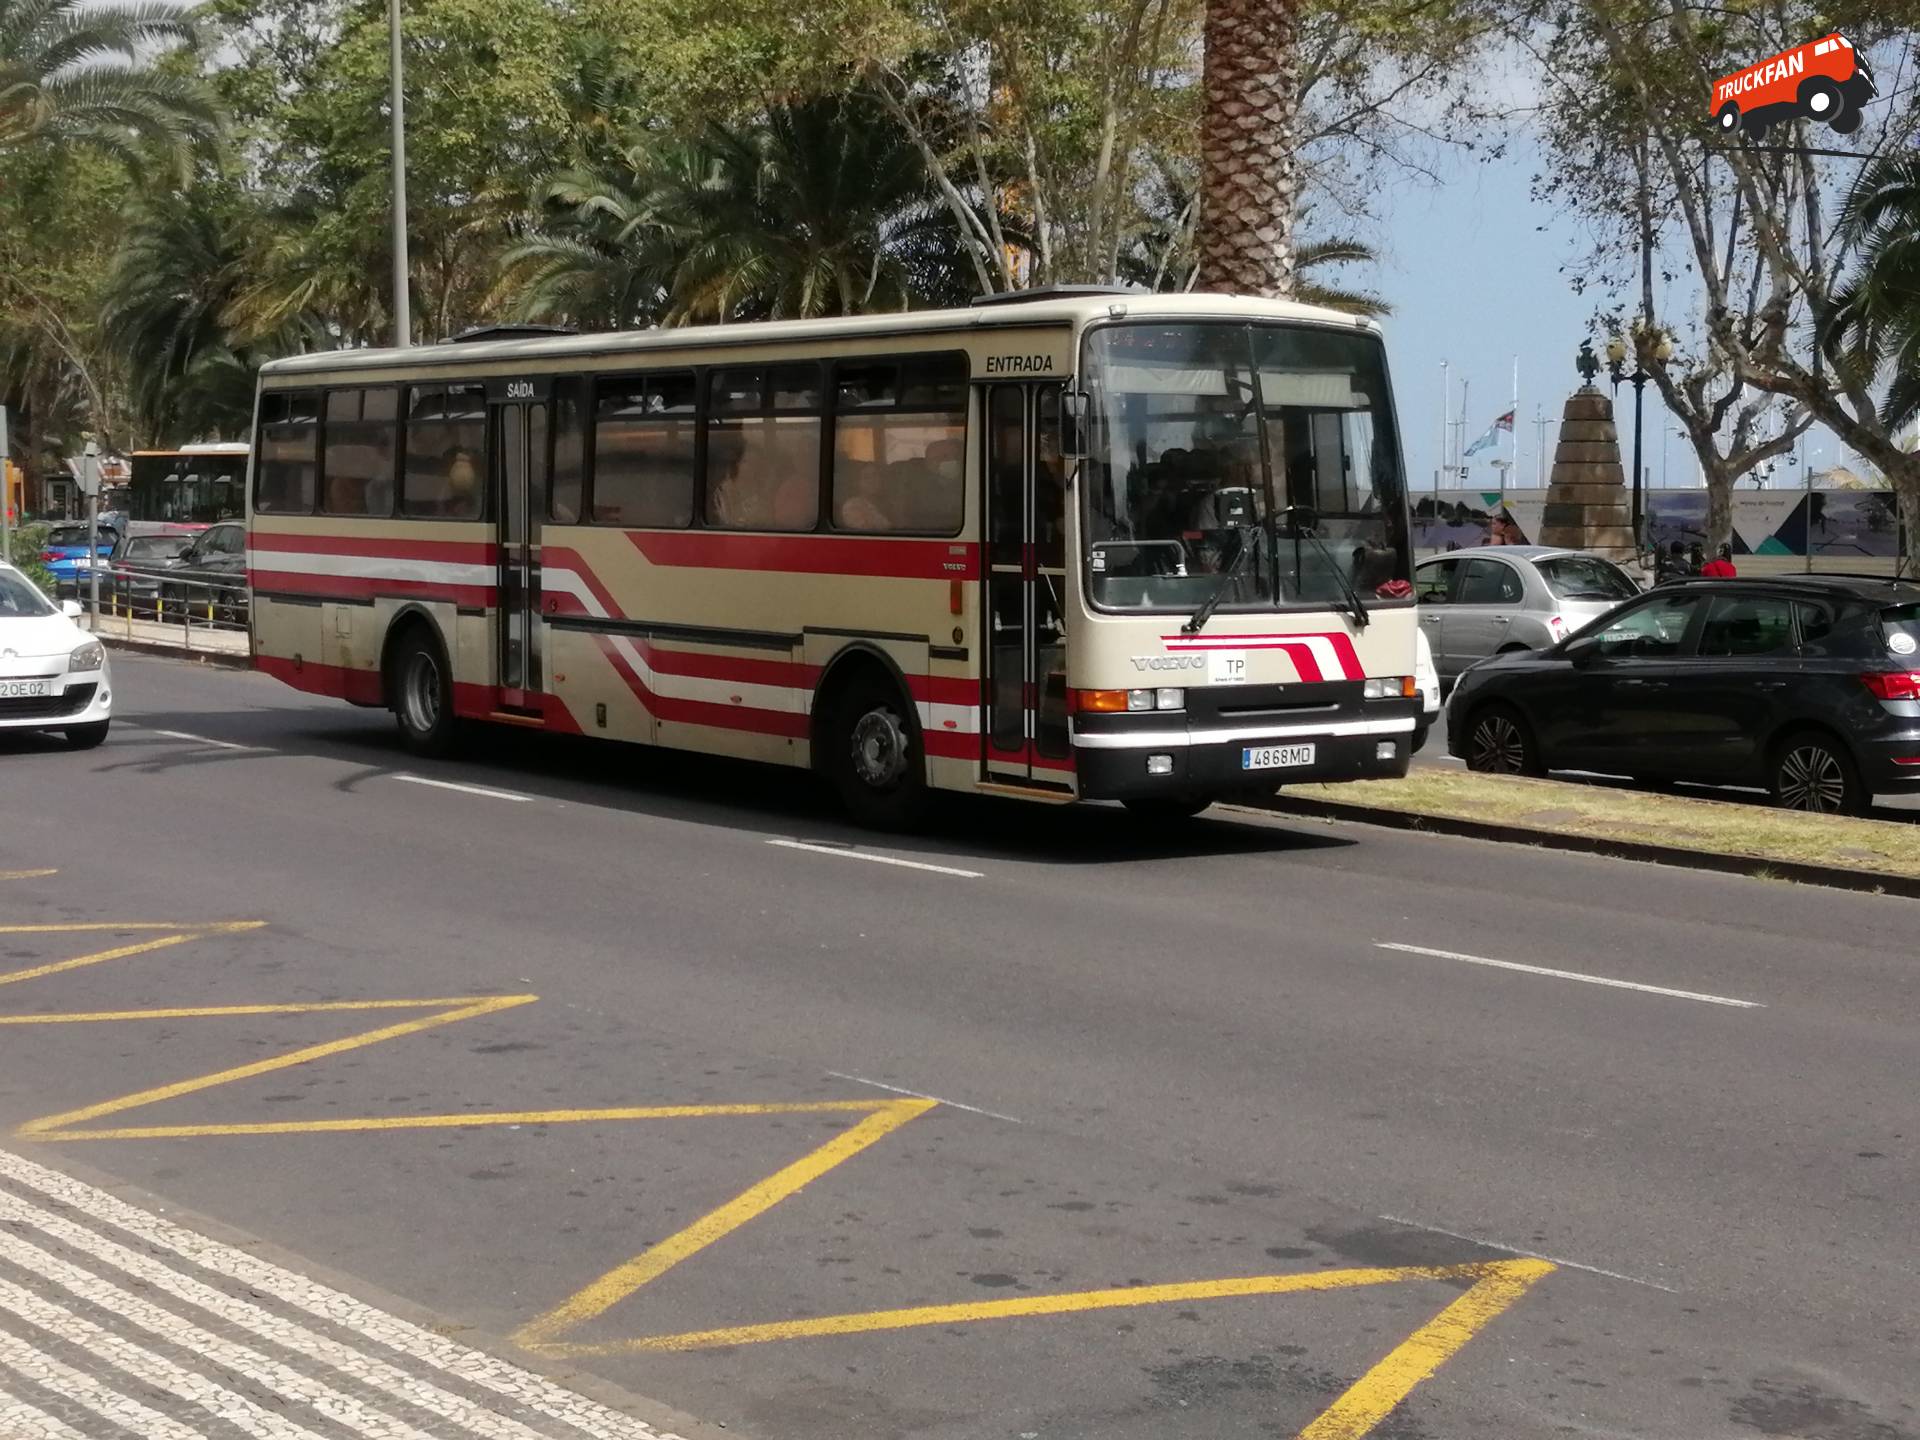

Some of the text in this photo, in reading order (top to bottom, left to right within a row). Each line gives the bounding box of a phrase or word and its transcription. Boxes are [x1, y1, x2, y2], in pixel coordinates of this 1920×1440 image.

[986, 355, 1053, 373] ENTRADA
[506, 379, 535, 398] SAÍDA
[1130, 654, 1207, 672] VOLVO
[1226, 659, 1245, 674] TP
